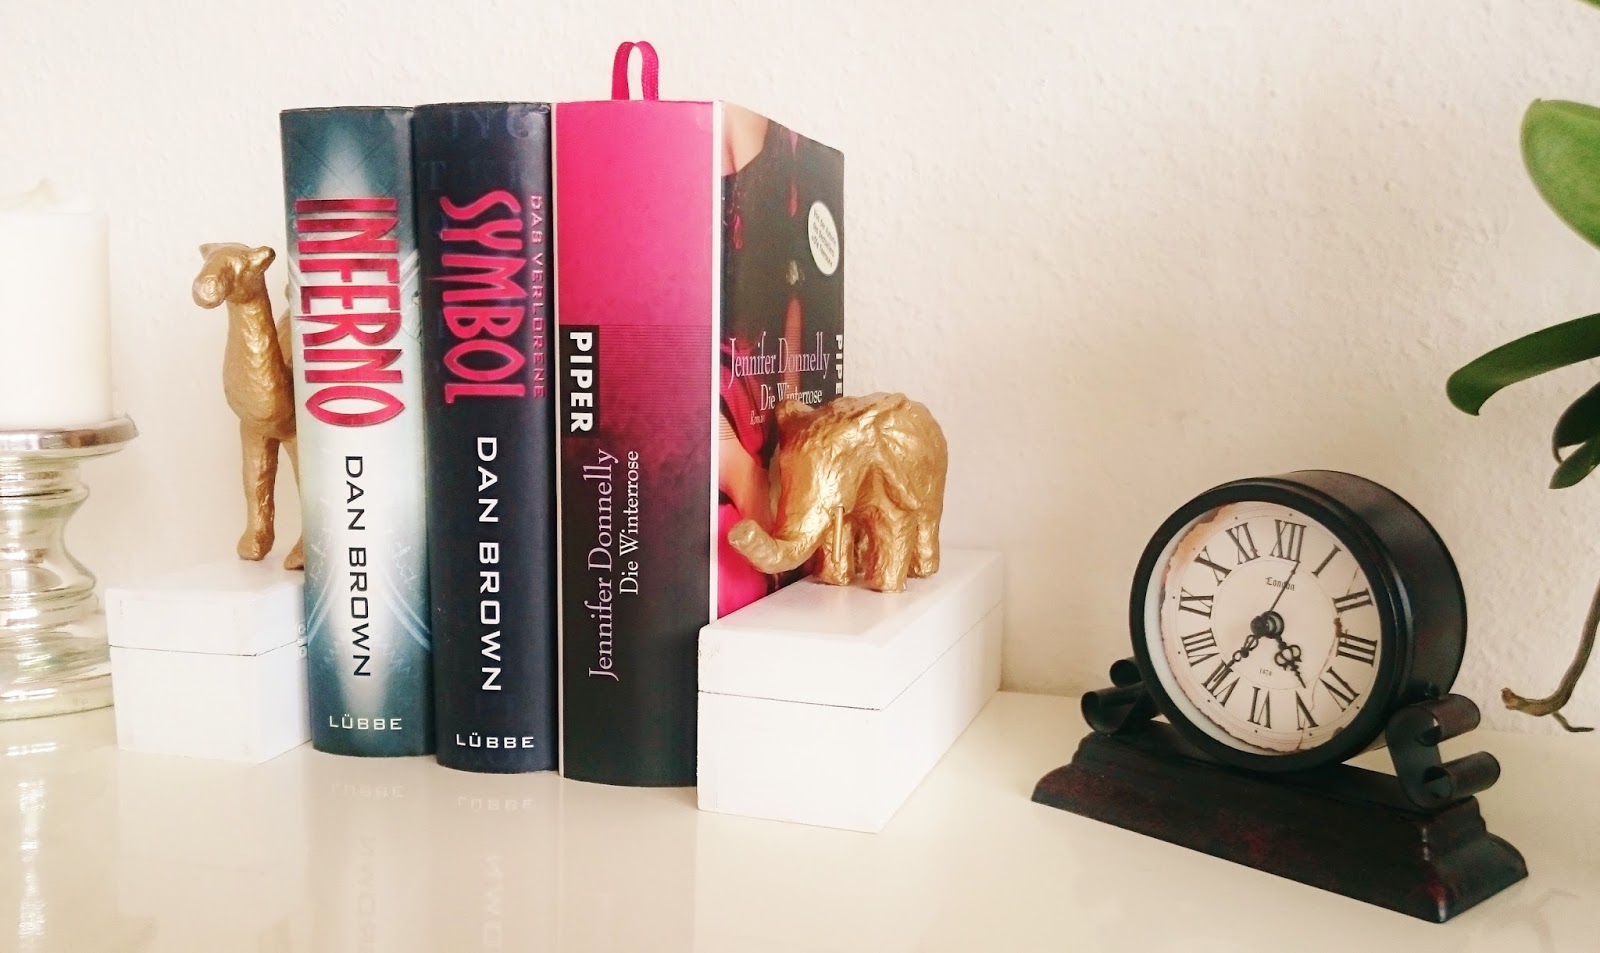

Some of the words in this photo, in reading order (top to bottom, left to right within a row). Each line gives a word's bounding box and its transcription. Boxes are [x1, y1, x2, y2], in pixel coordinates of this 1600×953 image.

[294, 196, 405, 427] INFERNO
[426, 190, 528, 404] SYMBOL
[531, 252, 545, 399] VERLORENE
[570, 331, 593, 433] PIPER
[728, 331, 776, 389] Jennifer
[778, 331, 830, 380] Donnelly
[835, 334, 843, 395] PIPE
[760, 383, 776, 411] Die
[345, 455, 366, 531] DAN
[476, 436, 499, 523] DAN
[583, 448, 619, 572] Donnelly
[619, 450, 639, 557] Winterrose
[1194, 546, 1232, 586] X
[1225, 522, 1261, 566] XI
[1269, 518, 1307, 564] XII
[619, 560, 639, 595] Die
[1178, 586, 1214, 619] IX
[1332, 587, 1374, 613] II
[349, 547, 371, 677] BROWN
[479, 542, 502, 691] BROWN
[584, 576, 619, 682] Jennifer
[1335, 631, 1378, 668] III
[329, 713, 403, 731] LÜBBE
[456, 732, 535, 749] LÜBBE
